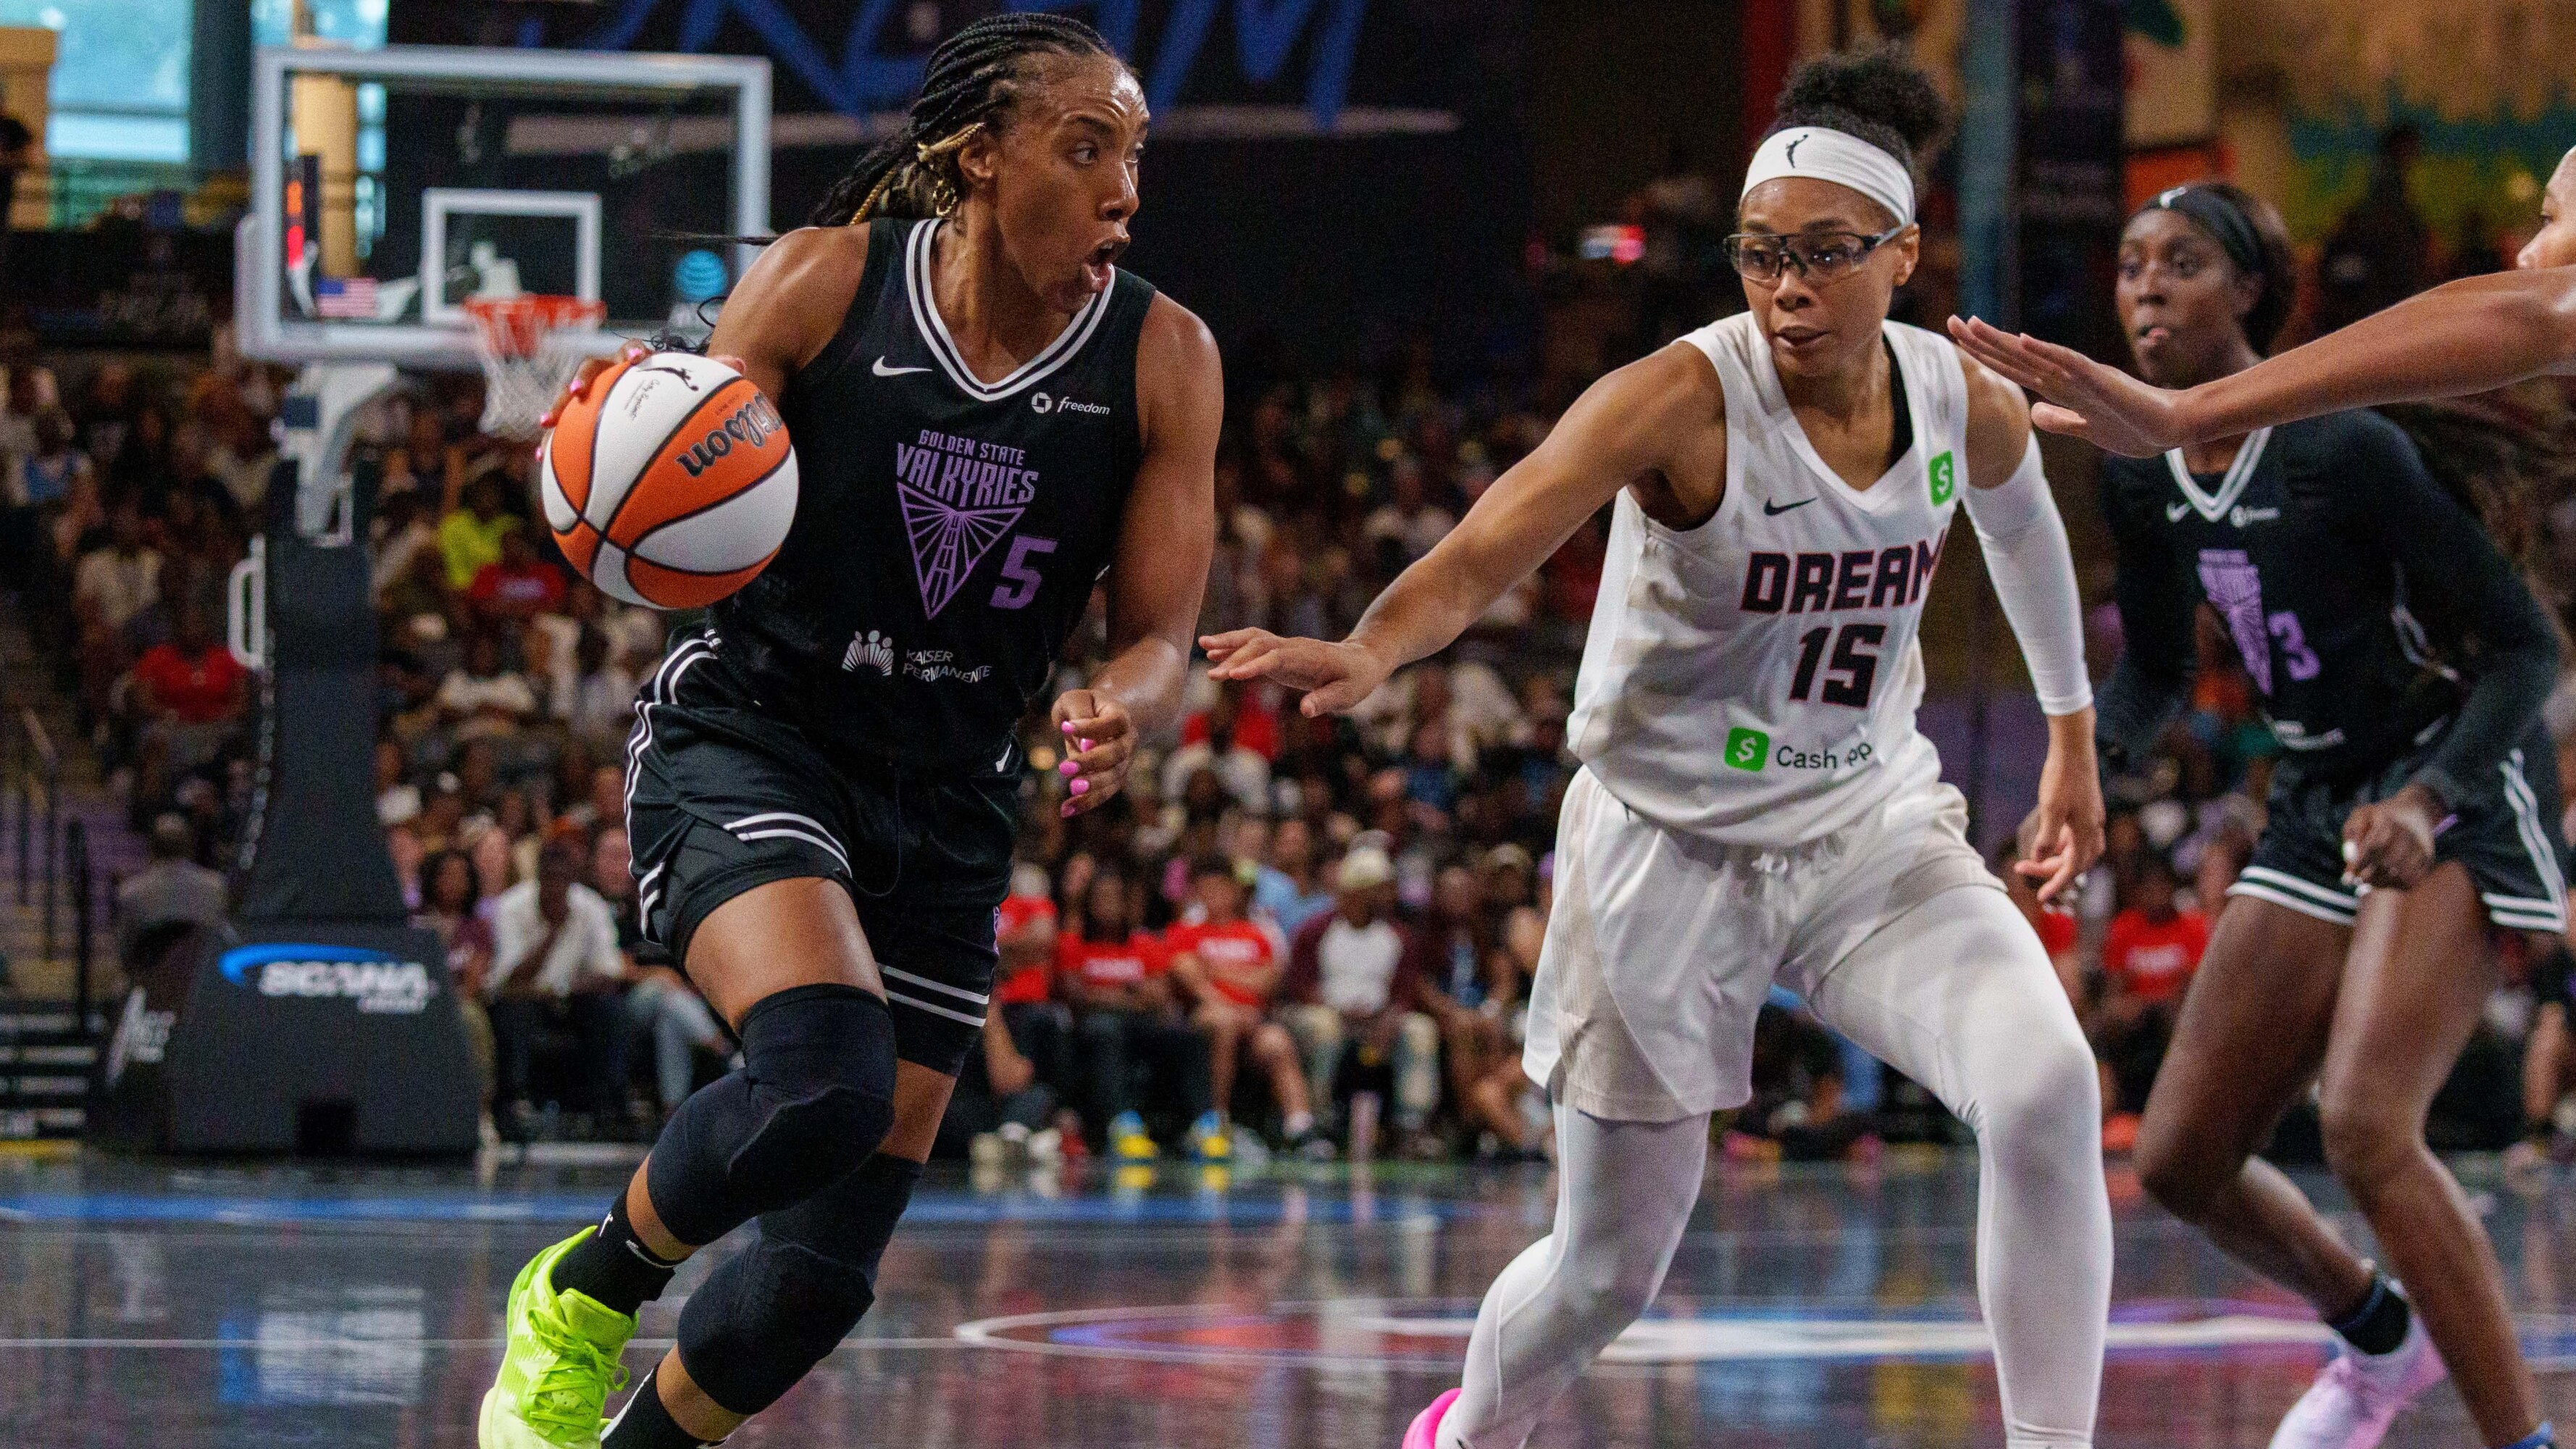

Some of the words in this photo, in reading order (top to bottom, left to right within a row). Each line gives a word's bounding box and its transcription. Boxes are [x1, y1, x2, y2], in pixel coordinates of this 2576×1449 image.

[1057, 396, 1111, 415] freedom
[918, 429, 975, 456] GOLDEN
[979, 443, 1026, 466] STATE
[896, 442, 1040, 507] VALKYRIES
[988, 533, 1058, 609] 5
[1739, 528, 1946, 614] DREAM
[906, 648, 954, 665] KAISER
[1789, 624, 1886, 709] 15
[2267, 610, 2321, 681] 3
[902, 662, 992, 684] PERMANENTE
[1776, 745, 1837, 769] Cash
[1843, 741, 1873, 767] pp
